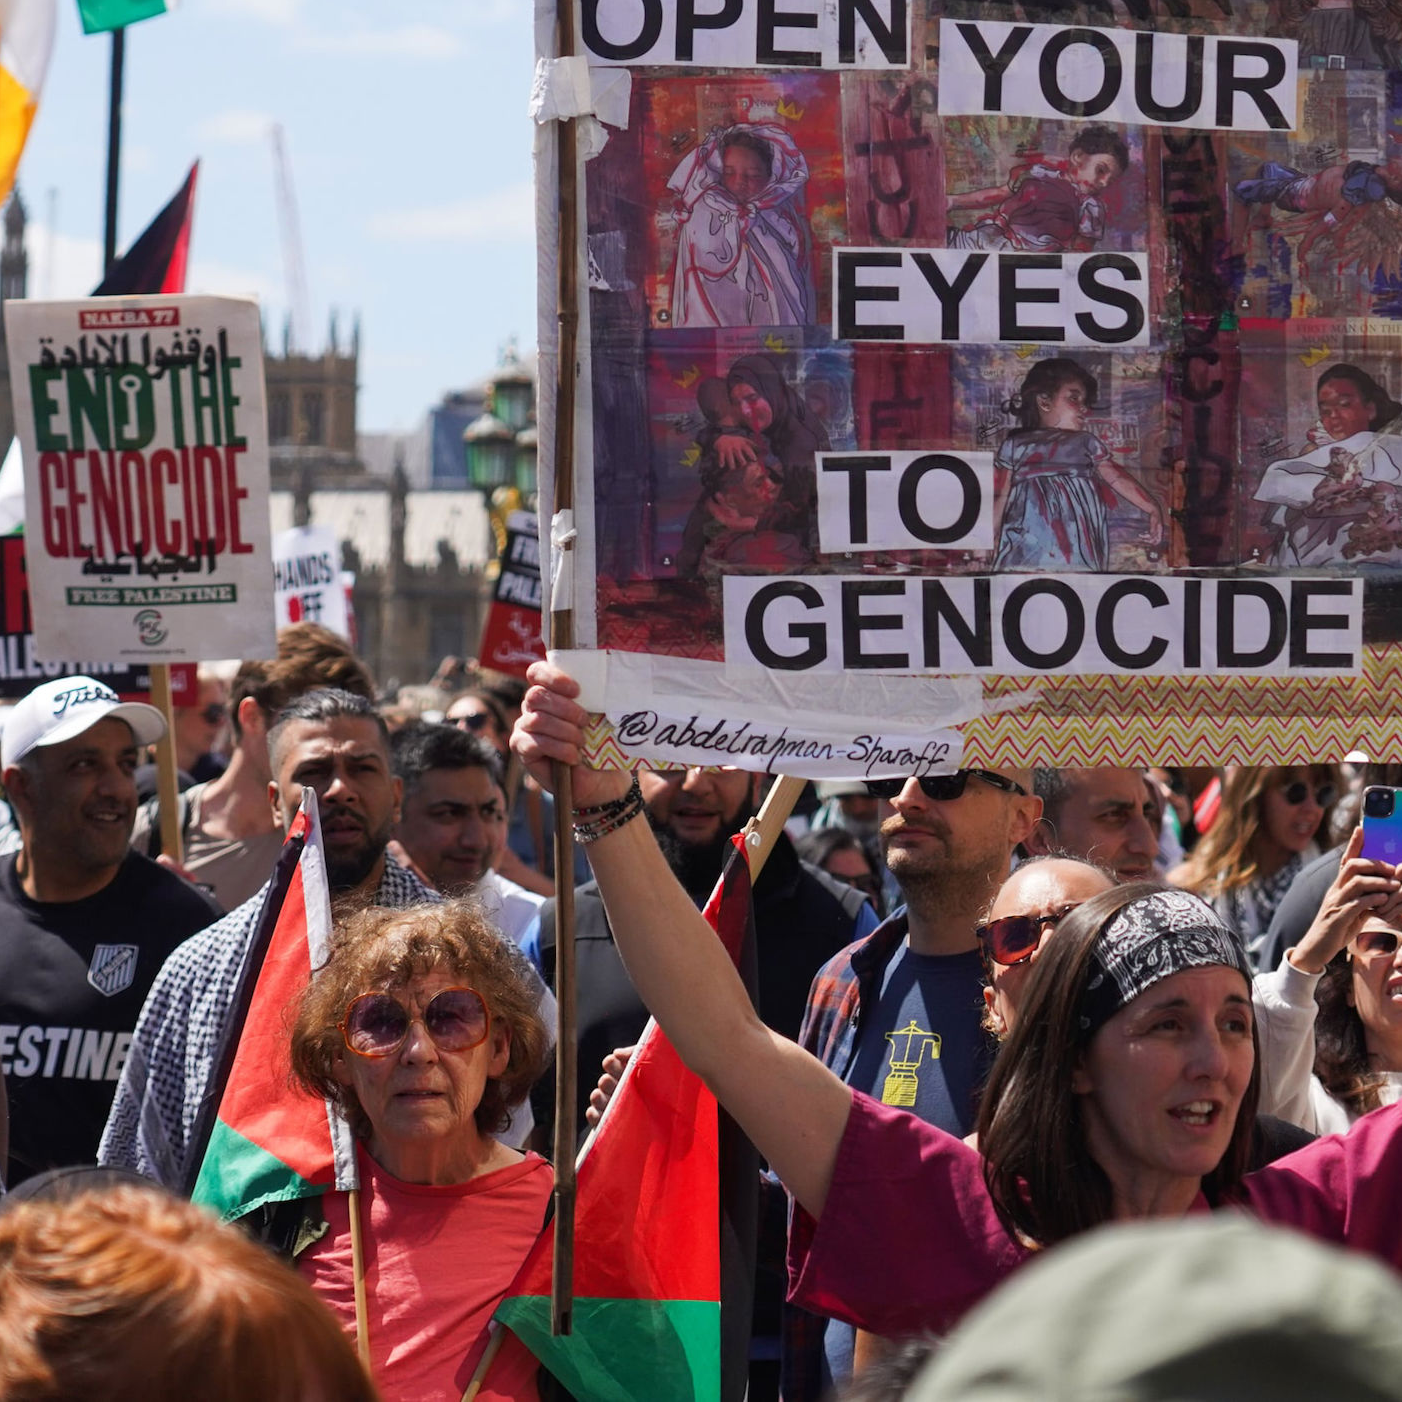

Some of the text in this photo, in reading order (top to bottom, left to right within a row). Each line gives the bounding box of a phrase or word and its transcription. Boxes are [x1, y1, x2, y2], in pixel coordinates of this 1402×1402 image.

[953, 23, 1293, 131] YOUR
[83, 309, 176, 326] NAKBA 77
[836, 251, 1146, 345] EYES
[29, 356, 247, 452] END THE
[39, 444, 255, 560] GENOCIDE
[821, 453, 982, 545] TO
[71, 586, 233, 604] FREE PALESTINE
[742, 577, 1356, 673] GENOCIDE
